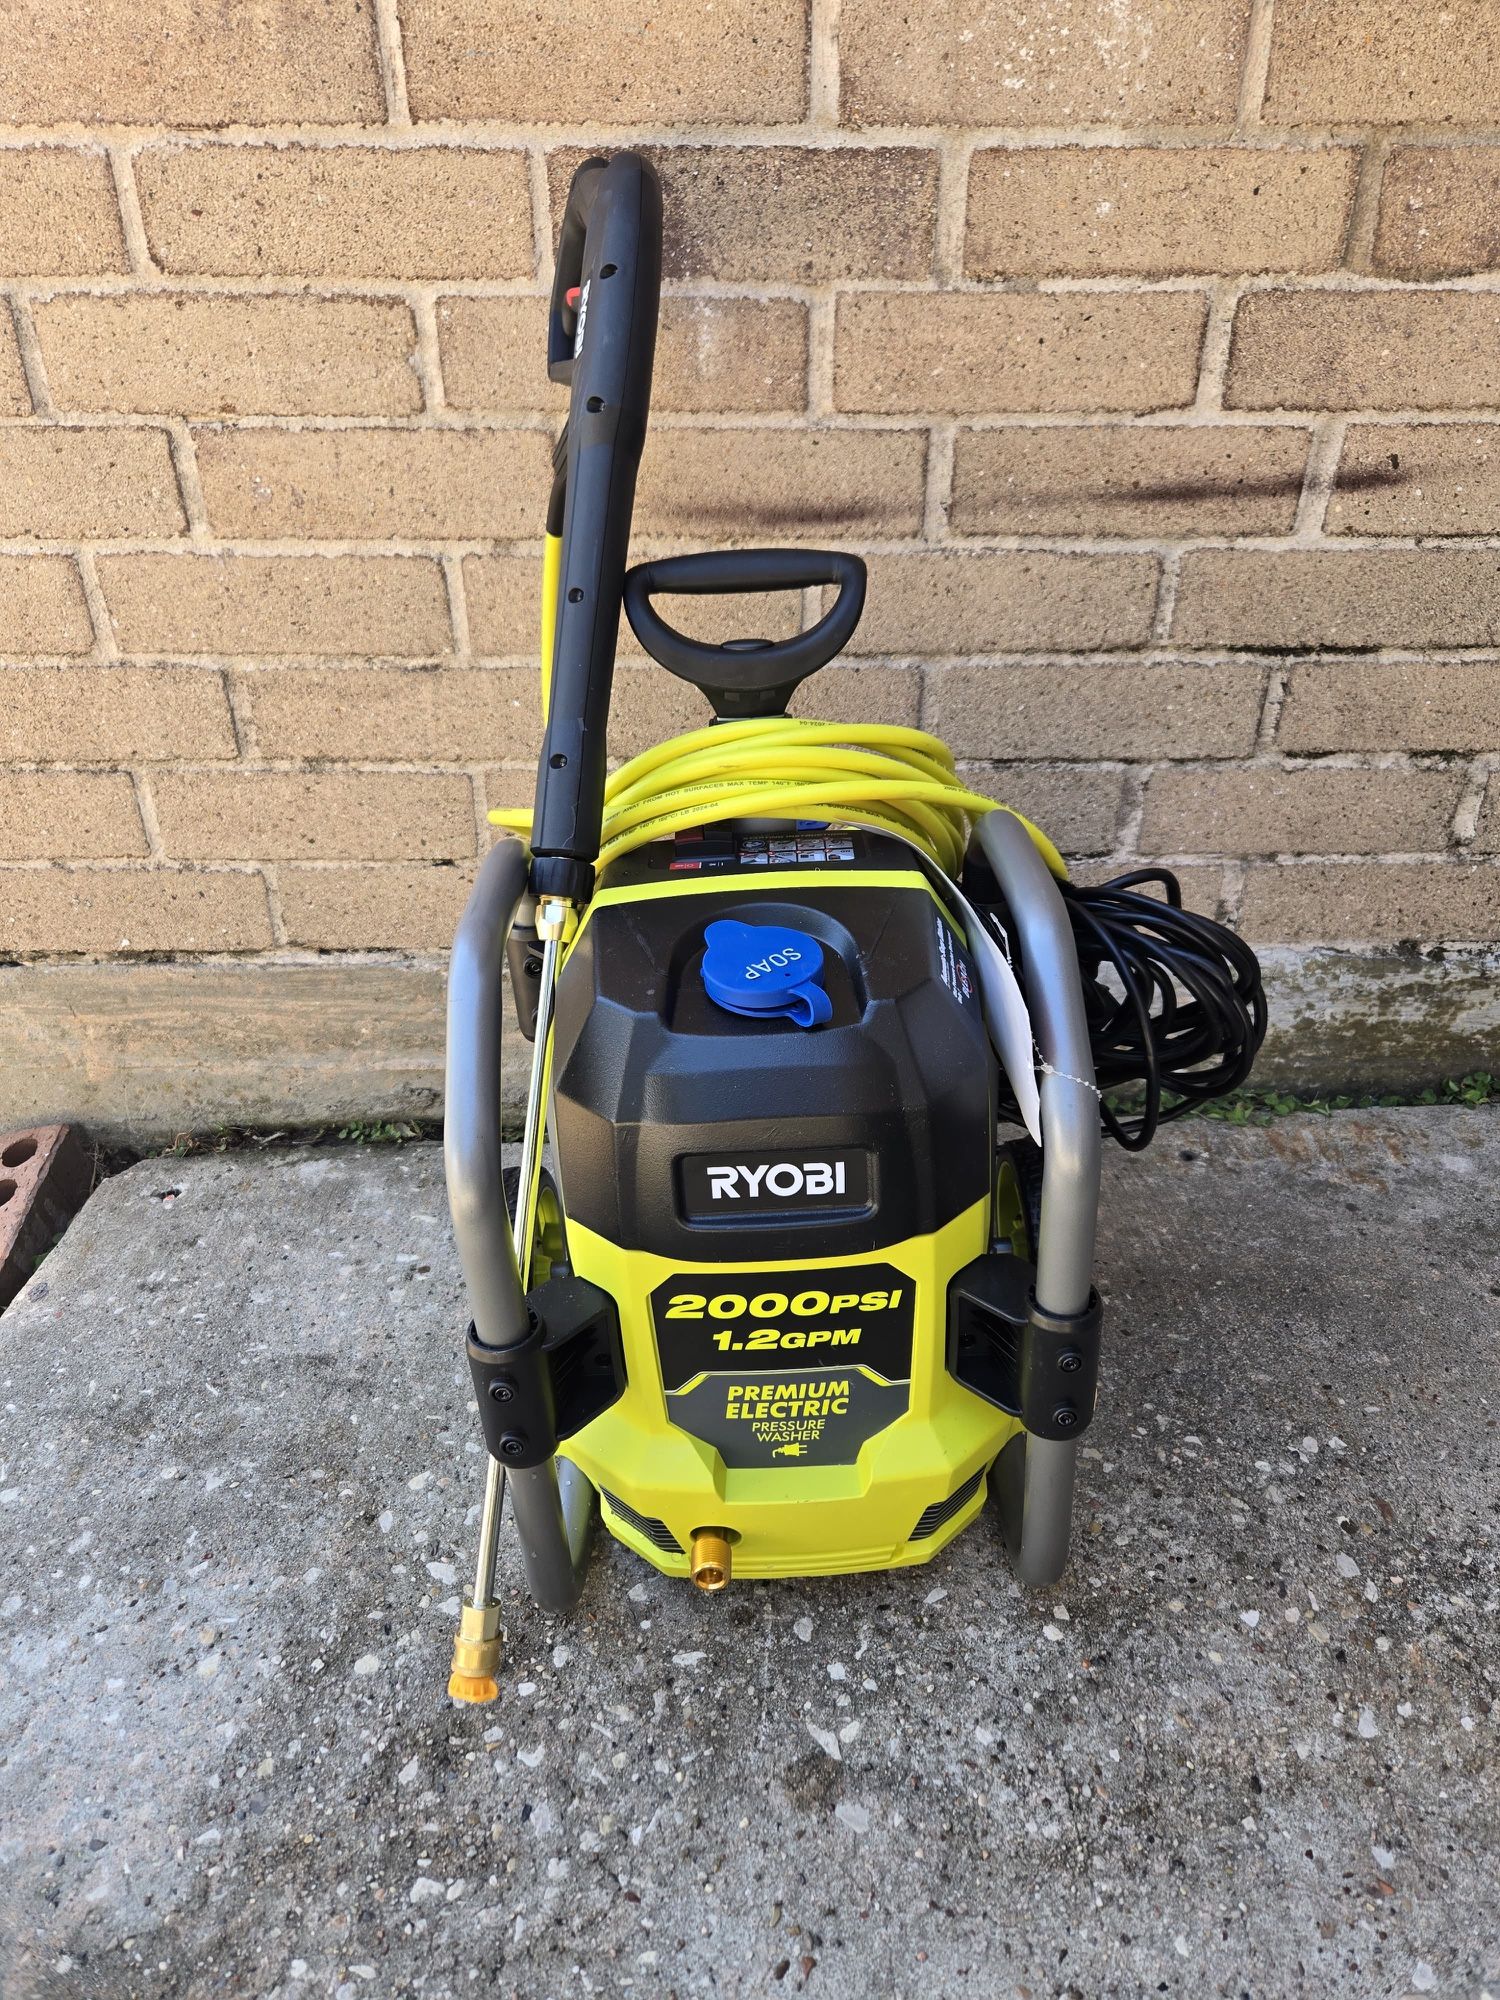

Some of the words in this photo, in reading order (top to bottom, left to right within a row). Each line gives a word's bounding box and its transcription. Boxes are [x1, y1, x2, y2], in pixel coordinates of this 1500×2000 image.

[623, 803, 641, 813] AWAY
[643, 794, 663, 804] FROM
[684, 783, 724, 793] SURFACES
[745, 948, 801, 979] SOAP
[706, 1161, 846, 1199] RYOBI
[665, 1289, 903, 1319] 2000PSI
[712, 1328, 862, 1351] 1.2GPM
[727, 1380, 850, 1401] PREMIUM
[725, 1397, 850, 1419] ELECTRIC
[752, 1418, 826, 1432] PRESSURE
[756, 1430, 820, 1442] WASHER
